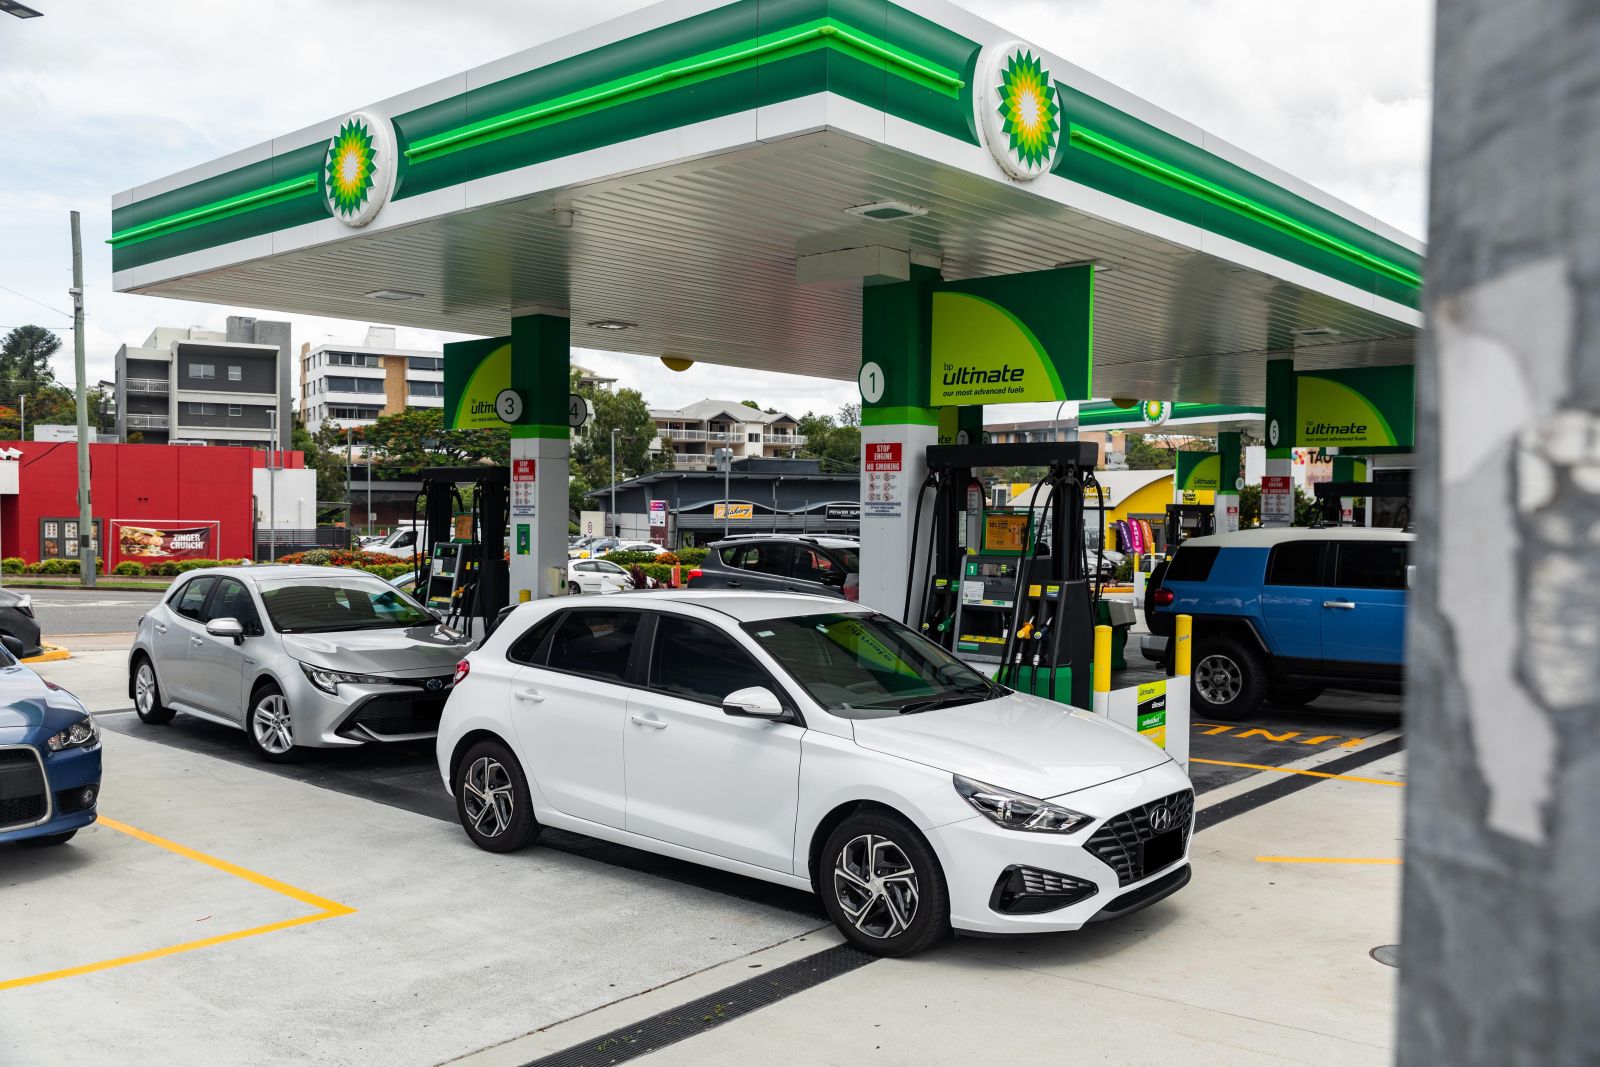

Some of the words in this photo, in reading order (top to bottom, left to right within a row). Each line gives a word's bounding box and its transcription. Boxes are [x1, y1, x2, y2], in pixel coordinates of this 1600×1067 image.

[944, 362, 953, 372] bp
[943, 364, 1024, 386] ultimate
[869, 371, 876, 394] 1
[955, 389, 973, 397] most
[973, 386, 1007, 396] advanced
[1007, 385, 1025, 394] fuels
[471, 401, 497, 415] ultim
[504, 398, 514, 414] 3
[569, 402, 579, 419] 4
[1305, 422, 1367, 435] ultimate
[866, 463, 874, 471] NO
[875, 462, 900, 471] SMOKING
[173, 534, 200, 542] ZINGER
